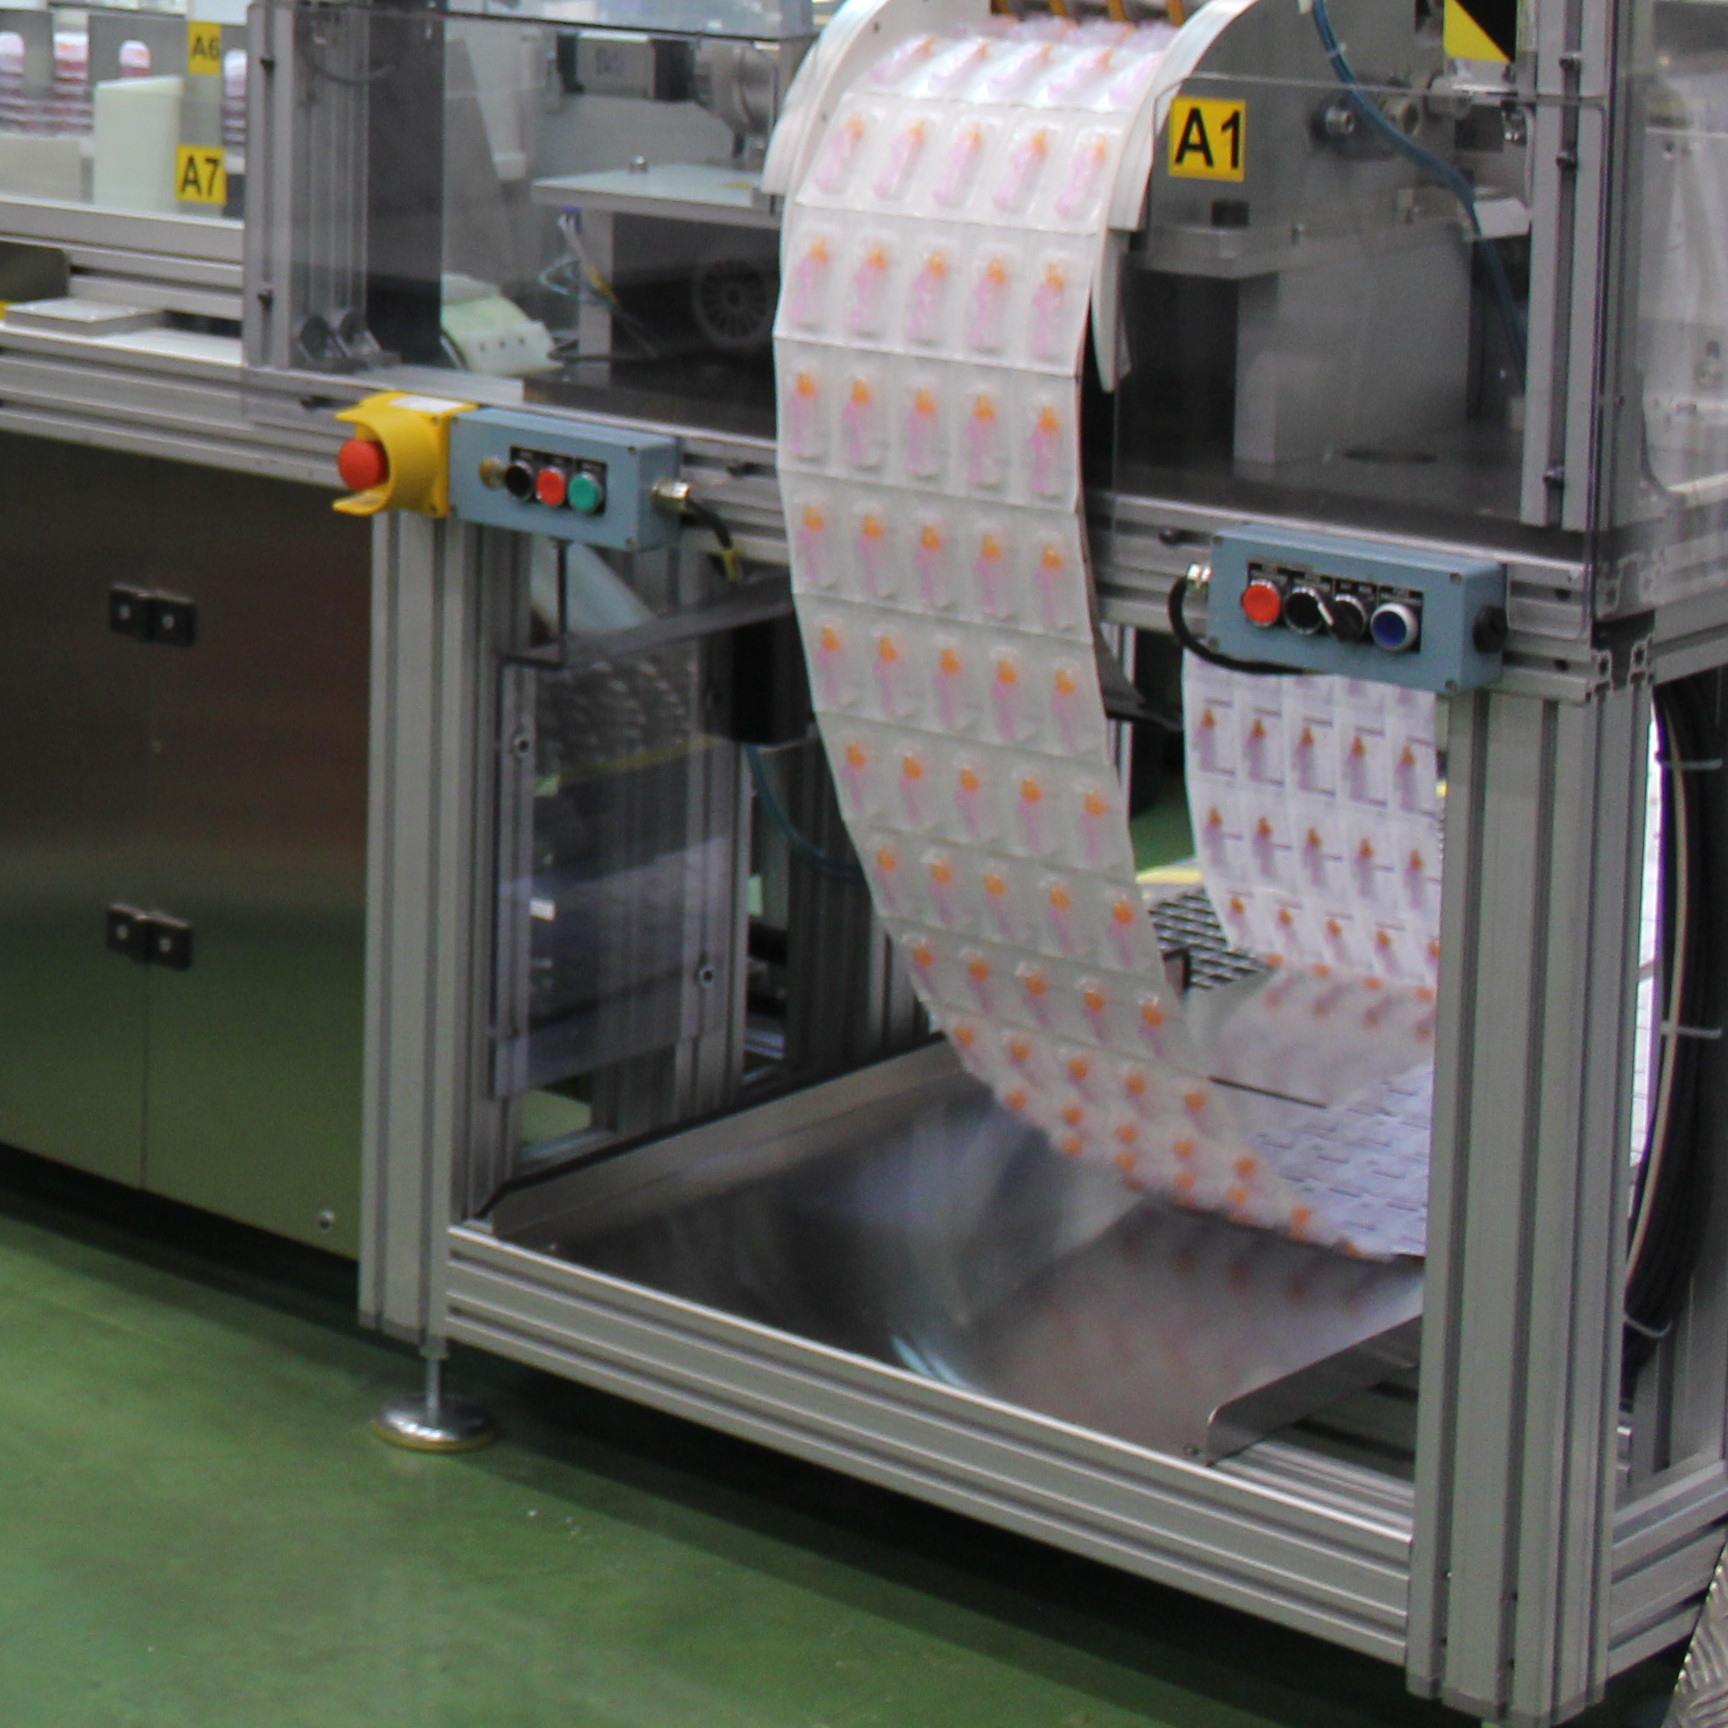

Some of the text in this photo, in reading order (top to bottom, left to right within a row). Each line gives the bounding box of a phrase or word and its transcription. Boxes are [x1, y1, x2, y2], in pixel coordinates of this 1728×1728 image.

[192, 36, 221, 62] A6
[1174, 107, 1241, 170] A1
[180, 155, 220, 198] A7
